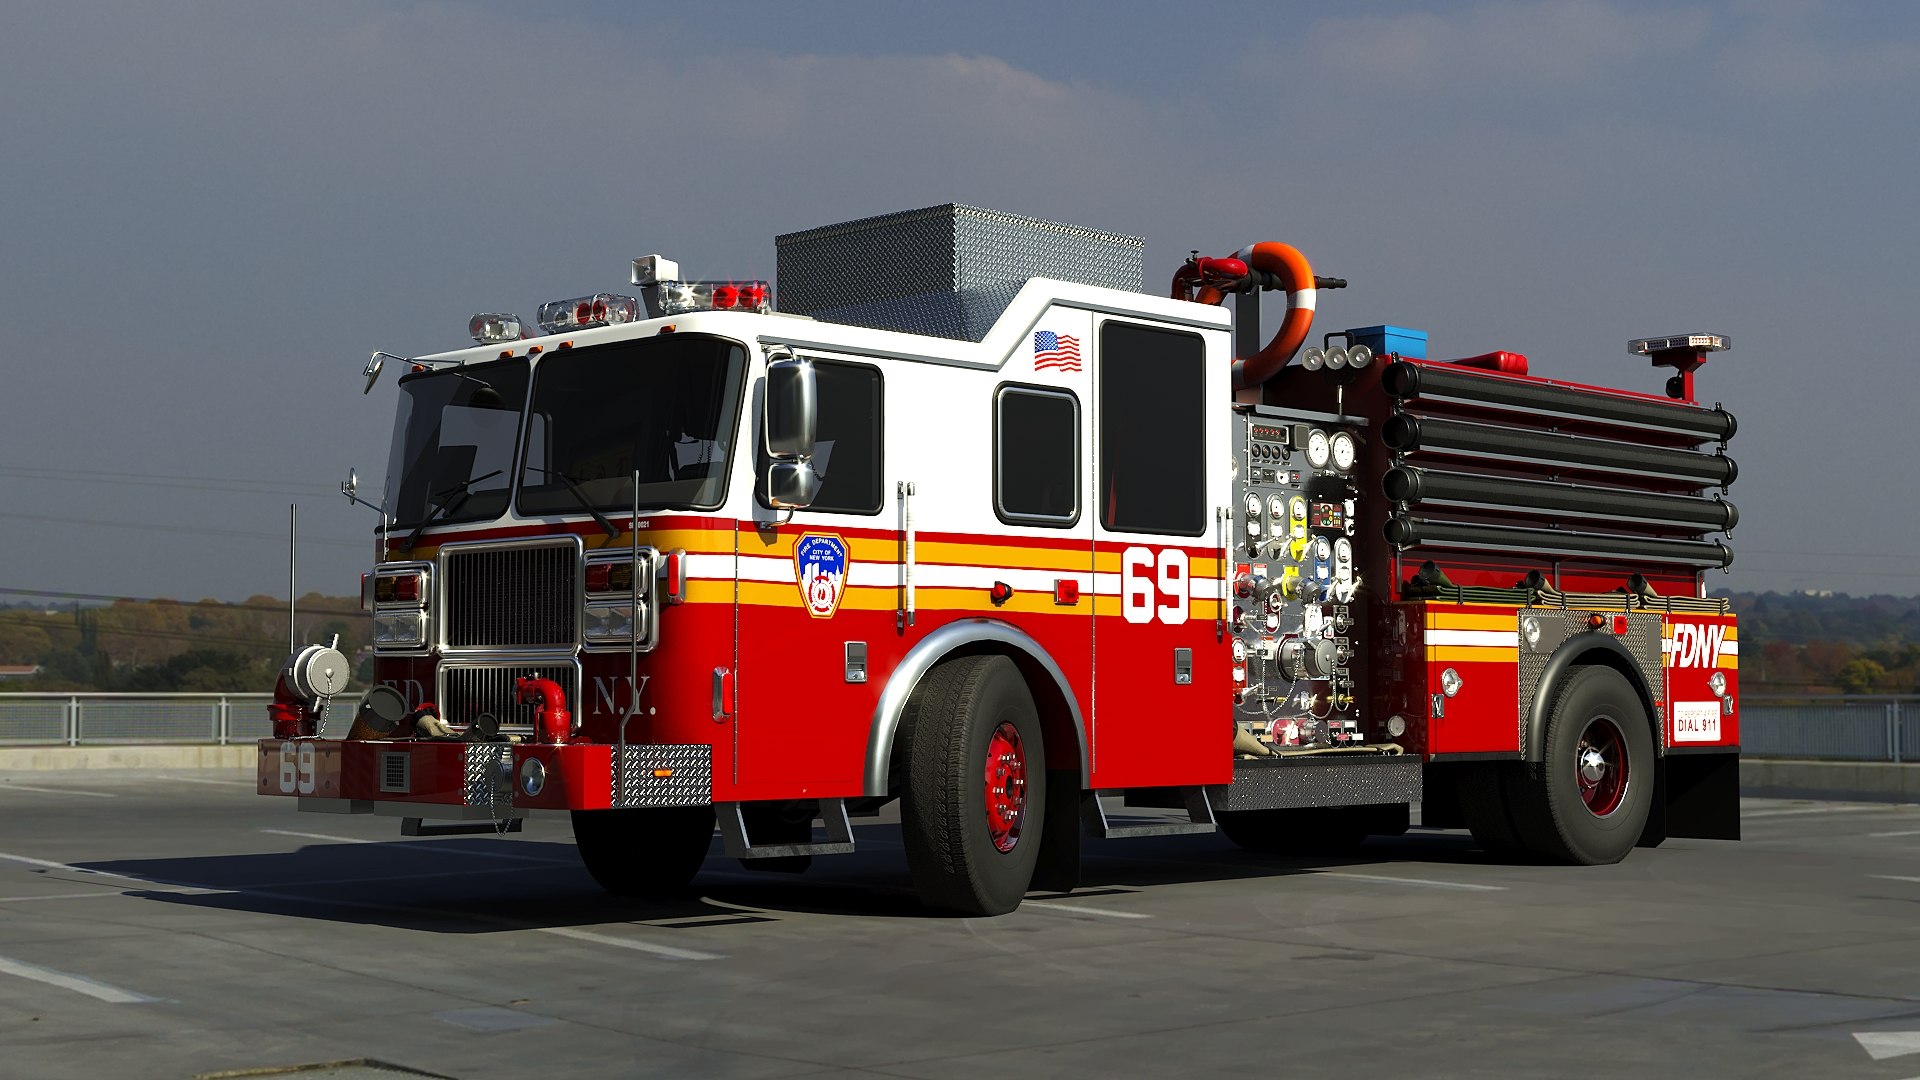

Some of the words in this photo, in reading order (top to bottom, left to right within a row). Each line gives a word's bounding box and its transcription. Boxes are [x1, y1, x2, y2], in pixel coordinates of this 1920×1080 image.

[801, 543, 811, 556] FIRE
[812, 538, 843, 558] DEPARTMENT
[1122, 546, 1189, 625] 69
[1669, 623, 1727, 669] FDNY
[592, 676, 657, 715] N.Y.
[1678, 719, 1699, 732] DIAL
[1702, 718, 1716, 732] 911
[279, 742, 316, 794] 69
